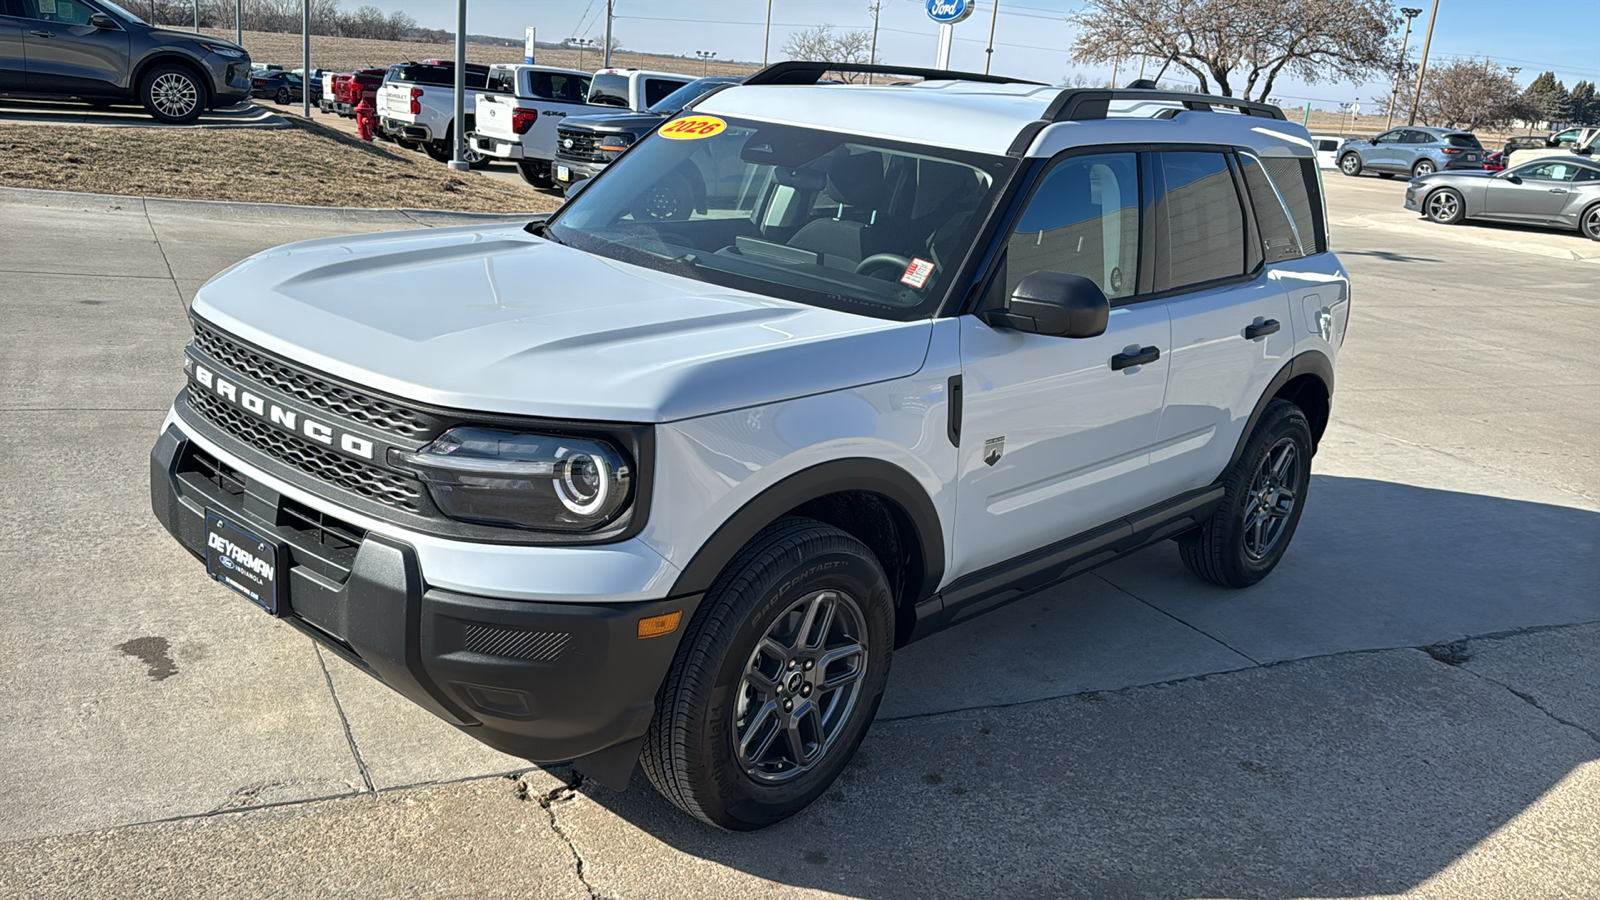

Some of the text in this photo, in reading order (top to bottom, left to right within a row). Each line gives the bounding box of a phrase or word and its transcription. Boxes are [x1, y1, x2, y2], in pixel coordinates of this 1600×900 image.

[931, 0, 958, 15] Ford
[663, 120, 721, 134] 2026
[195, 365, 374, 460] BRONCO
[208, 531, 274, 582] DEYARMAN
[235, 564, 263, 587] INDIANOLA
